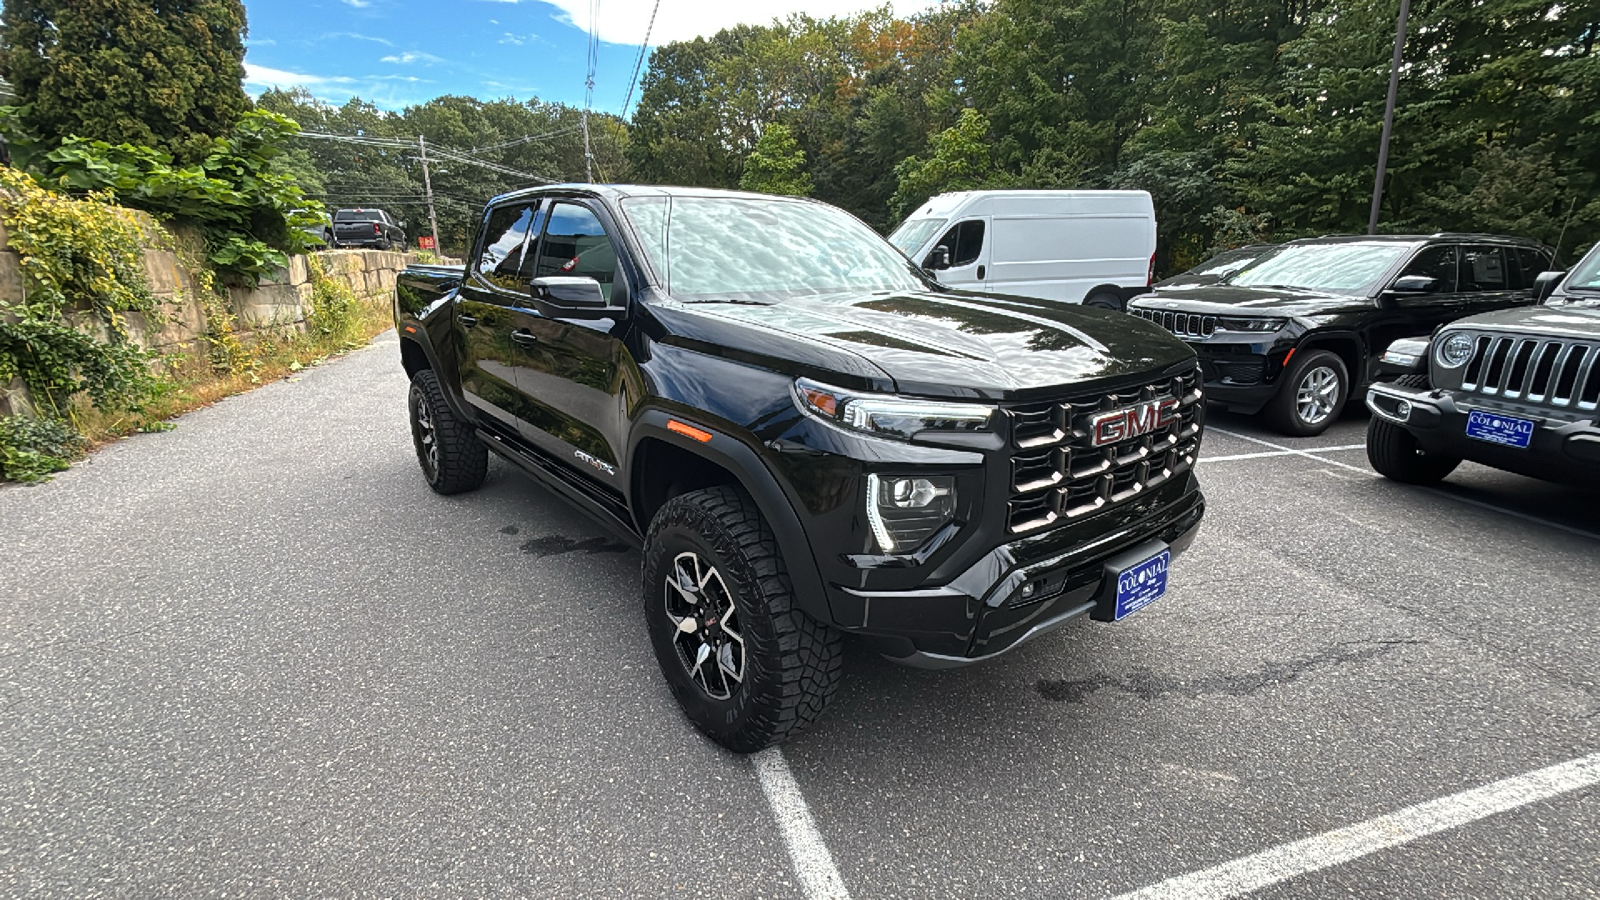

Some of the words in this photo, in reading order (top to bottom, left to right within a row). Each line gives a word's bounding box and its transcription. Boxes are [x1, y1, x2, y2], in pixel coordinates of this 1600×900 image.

[1092, 398, 1180, 447] GMC
[1470, 414, 1530, 434] COLONIAL
[1119, 559, 1168, 594] COLONIAL
